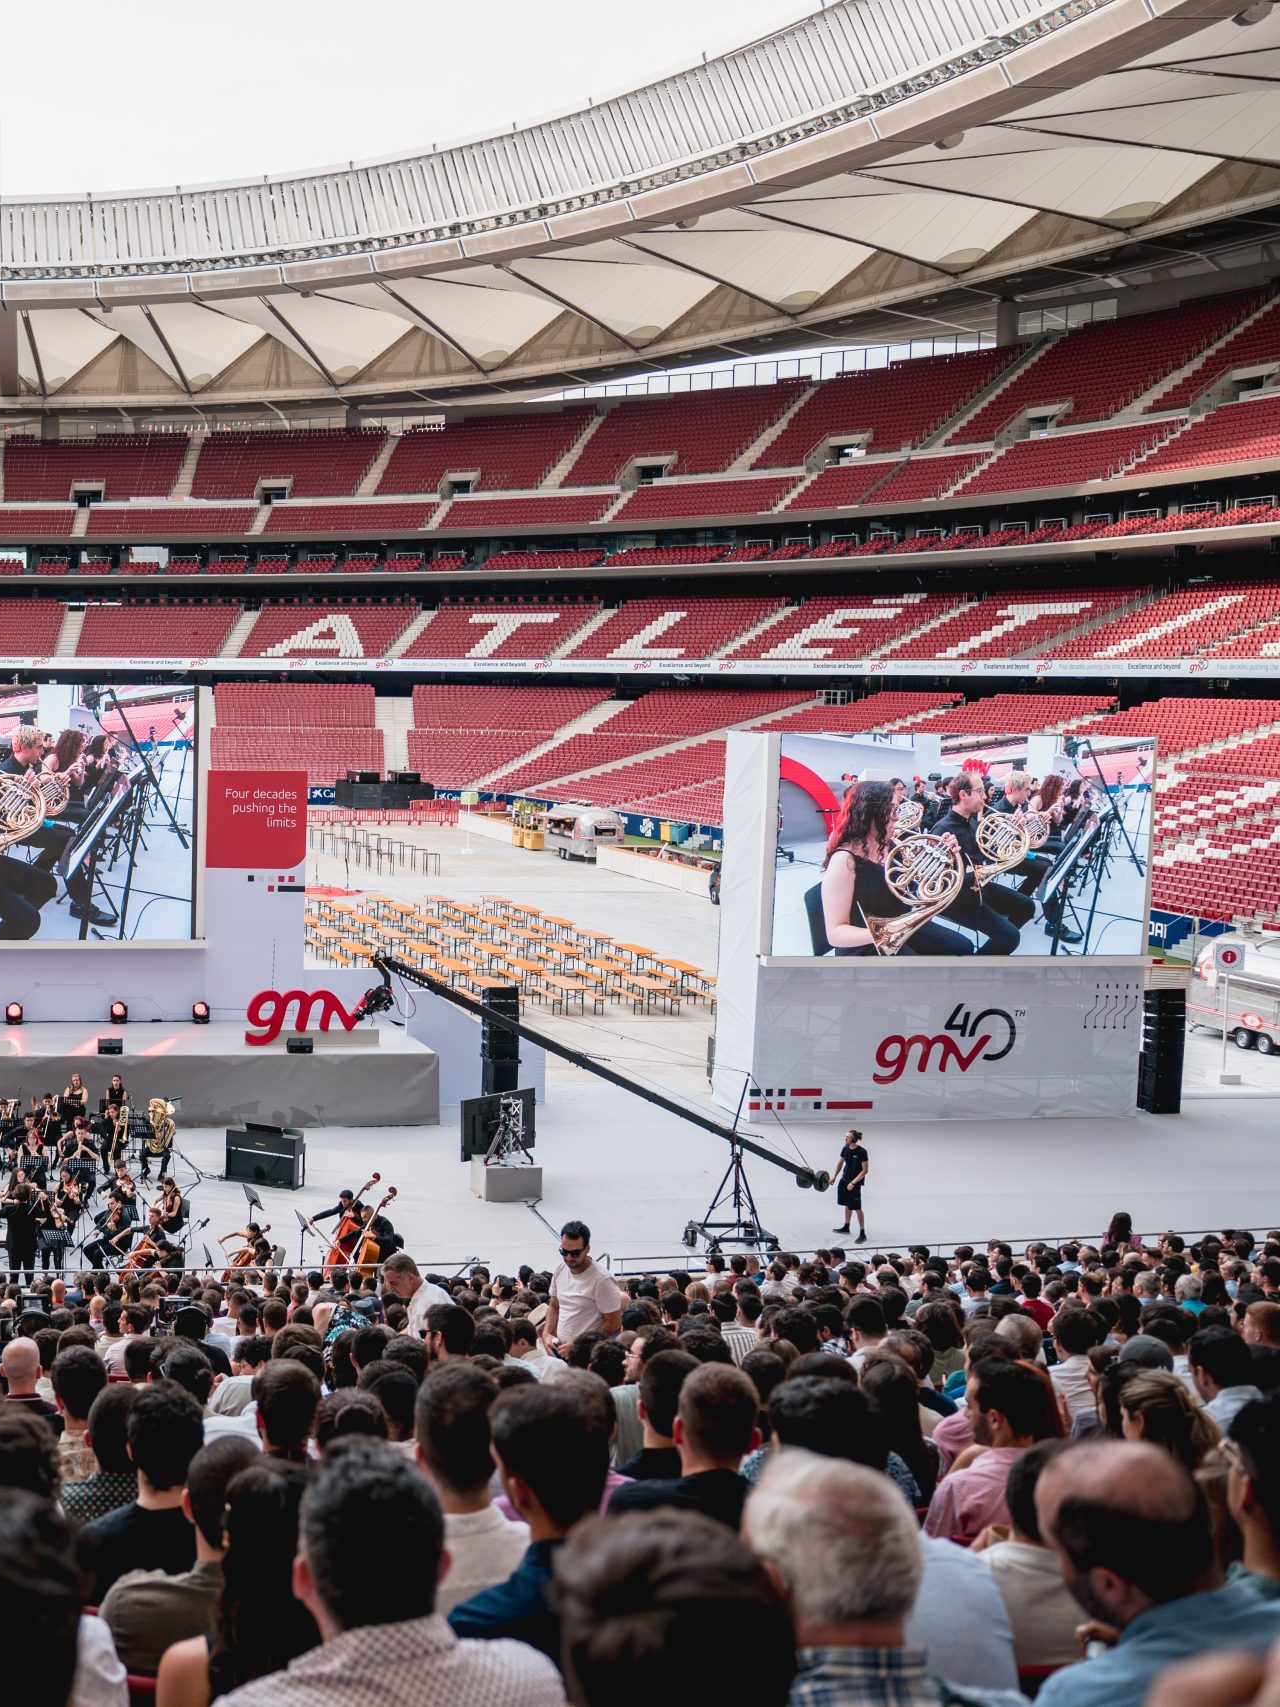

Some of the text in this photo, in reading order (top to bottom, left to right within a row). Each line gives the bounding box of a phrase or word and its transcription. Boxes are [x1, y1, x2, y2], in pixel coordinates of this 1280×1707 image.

[226, 788, 297, 799] Four decades
[232, 802, 296, 815] pushing the
[267, 817, 296, 827] limits
[245, 990, 373, 1046] gmv
[872, 1034, 992, 1084] gmv
